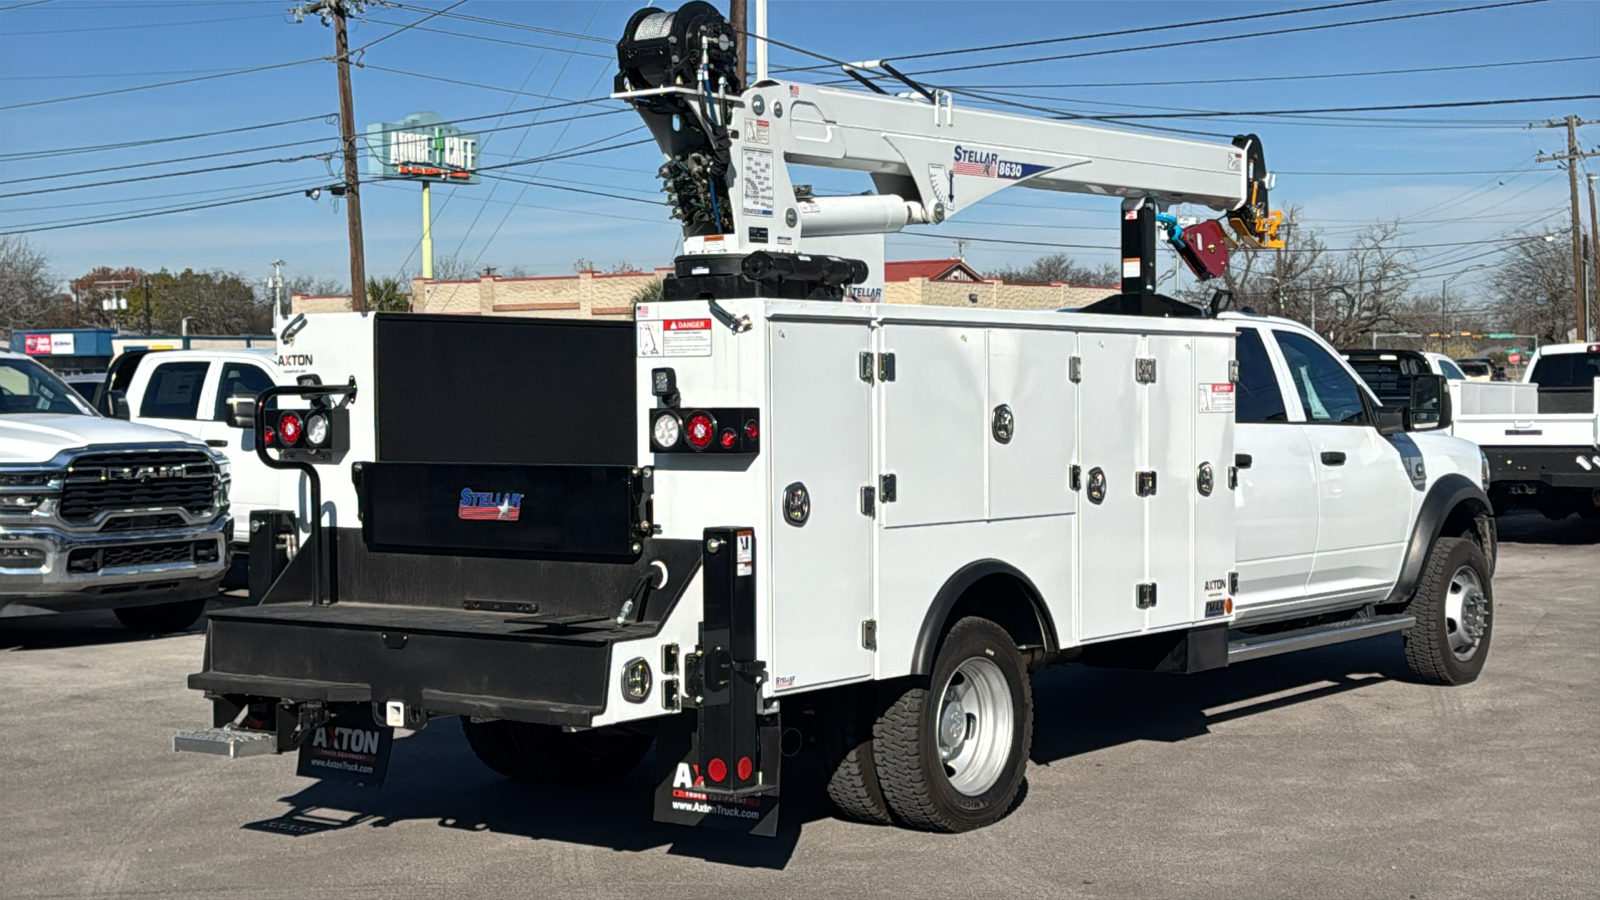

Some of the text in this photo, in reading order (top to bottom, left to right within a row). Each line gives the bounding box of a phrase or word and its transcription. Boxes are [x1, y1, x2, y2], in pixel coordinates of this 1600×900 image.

[953, 145, 1022, 178] STELLAR 8630
[845, 285, 882, 298] TELLAR
[678, 320, 706, 329] DANGER
[278, 354, 313, 367] AXTON
[108, 466, 183, 480] RAM
[460, 487, 522, 508] STELLAR
[1204, 579, 1227, 591] AXTON
[312, 726, 379, 754] AXTON
[310, 758, 374, 774] www.AxtonTruck.com
[685, 791, 707, 800] TRUCK
[672, 801, 760, 820] www.AxtonTruck.com
